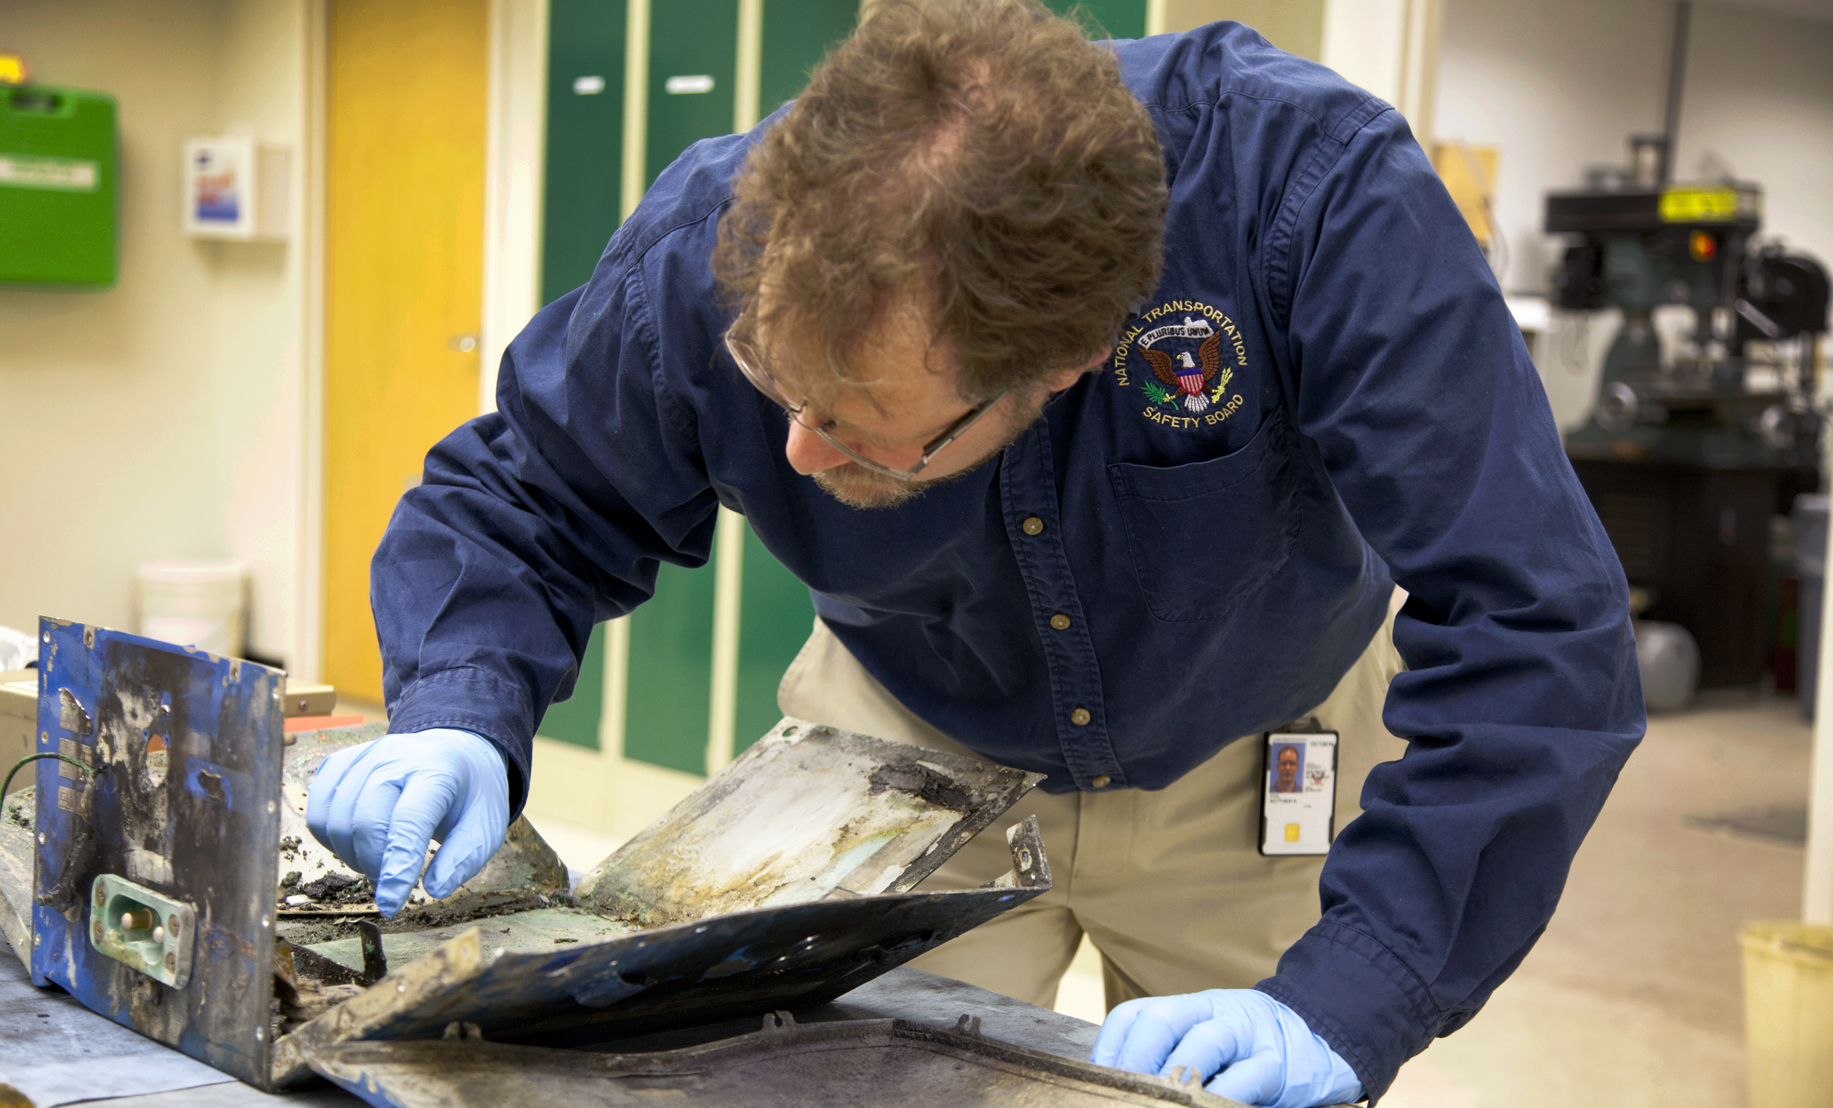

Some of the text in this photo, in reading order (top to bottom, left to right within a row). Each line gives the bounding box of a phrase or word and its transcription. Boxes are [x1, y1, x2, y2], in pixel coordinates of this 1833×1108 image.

[1114, 300, 1248, 387] NATIONAL TRANSPORTATION
[1147, 327, 1185, 342] PLURIBUS
[1142, 394, 1244, 429] SAFETY BOARD
